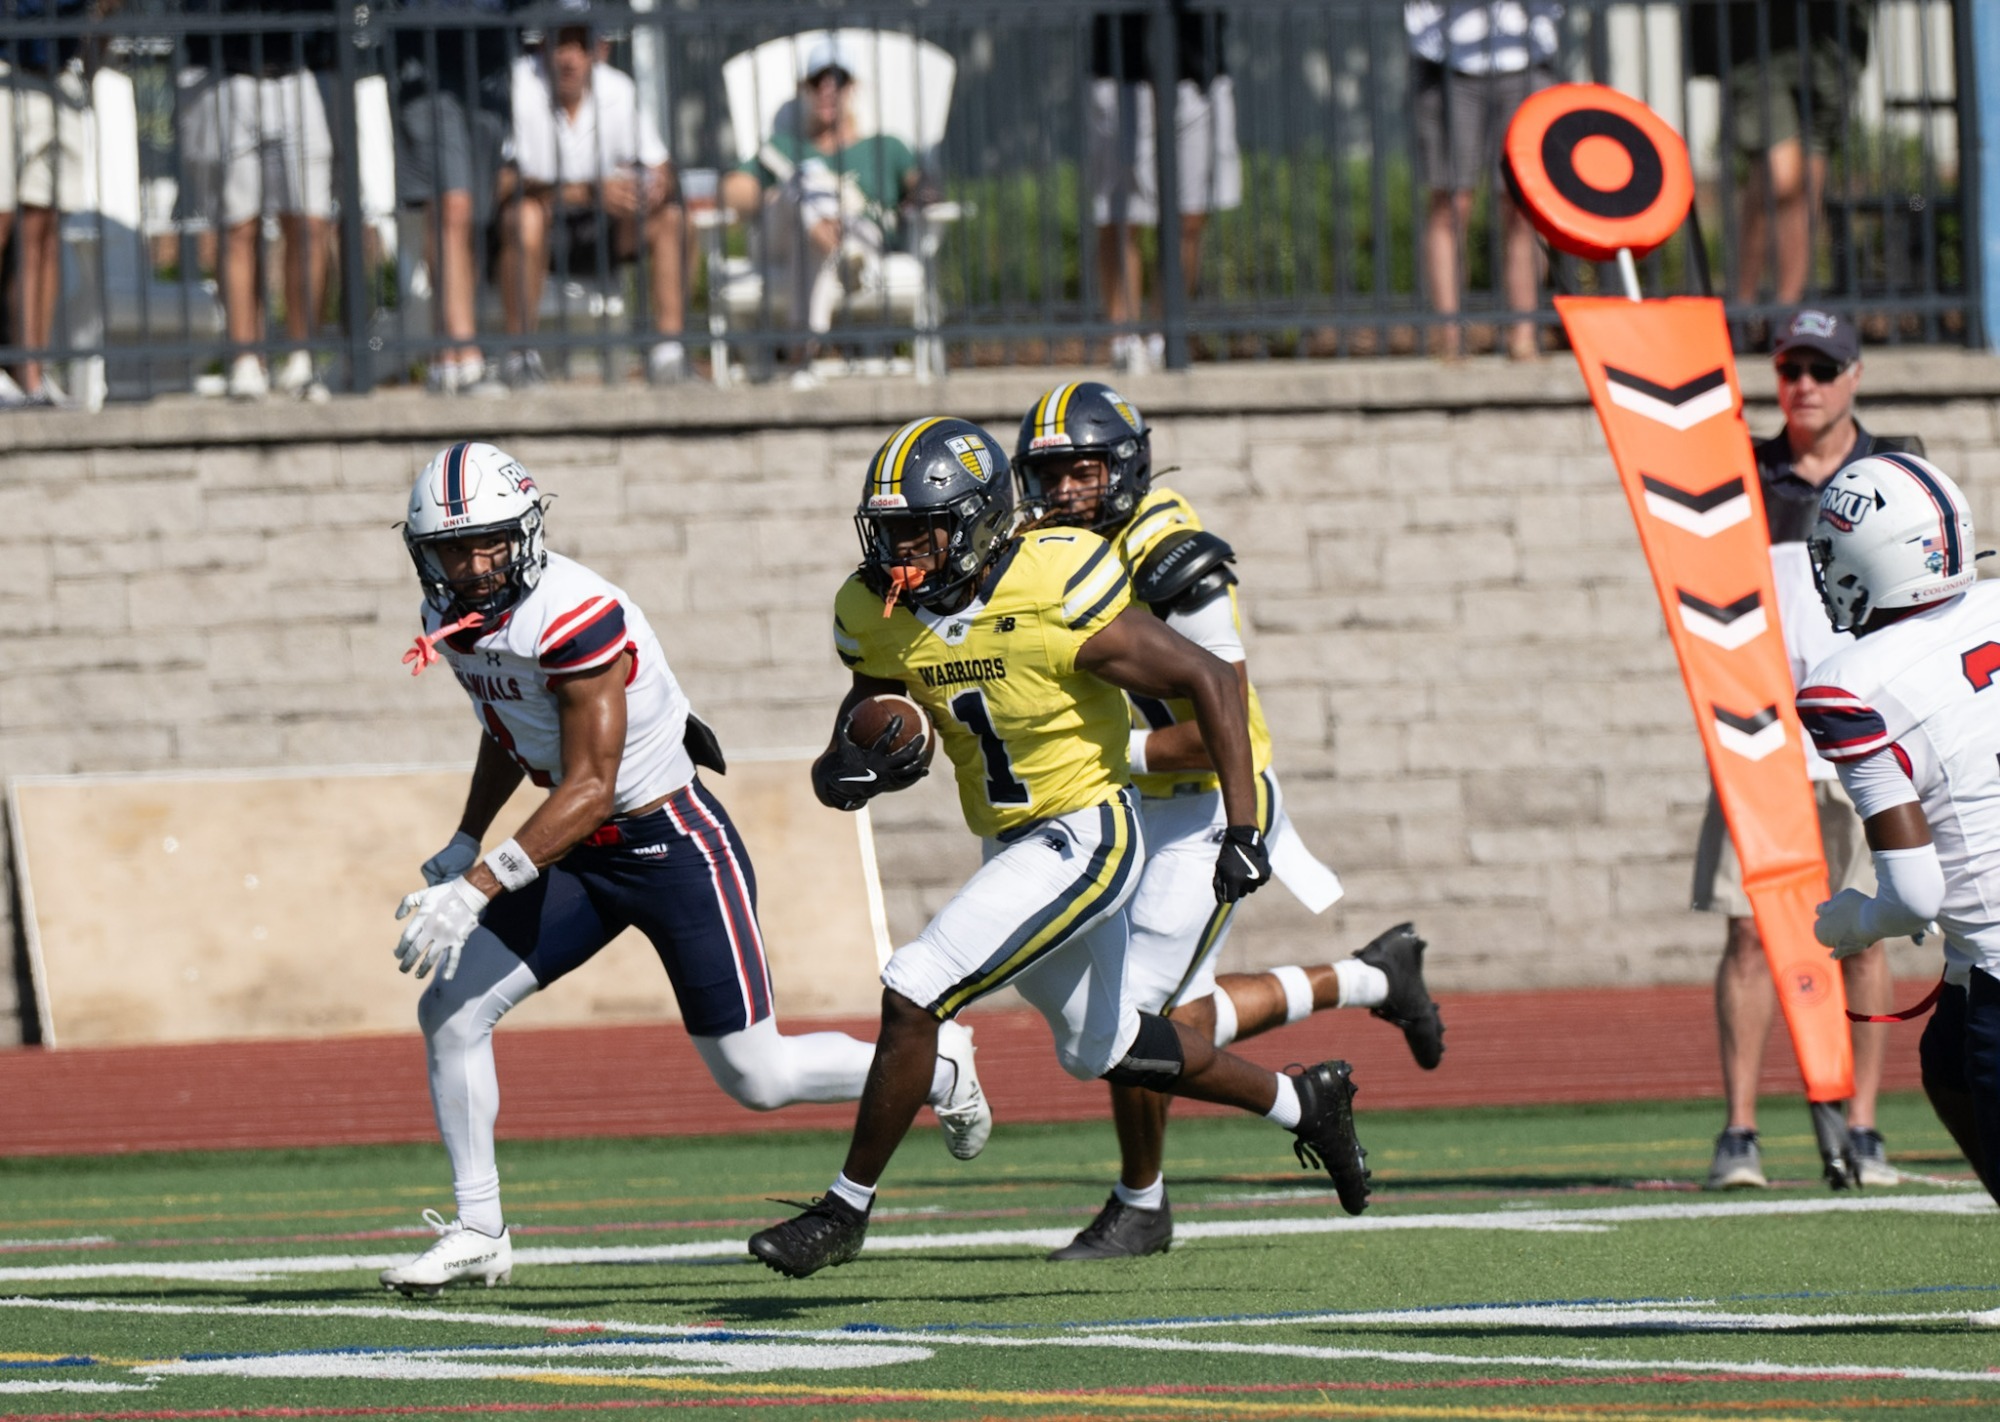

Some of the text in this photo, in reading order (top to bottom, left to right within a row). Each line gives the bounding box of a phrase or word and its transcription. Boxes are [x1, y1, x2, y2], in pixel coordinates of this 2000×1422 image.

[870, 498, 900, 507] Riddell
[443, 516, 472, 528] UNITE
[1148, 539, 1197, 586] XENITH
[918, 657, 1006, 688] WARRIORS
[950, 688, 1031, 806] 1
